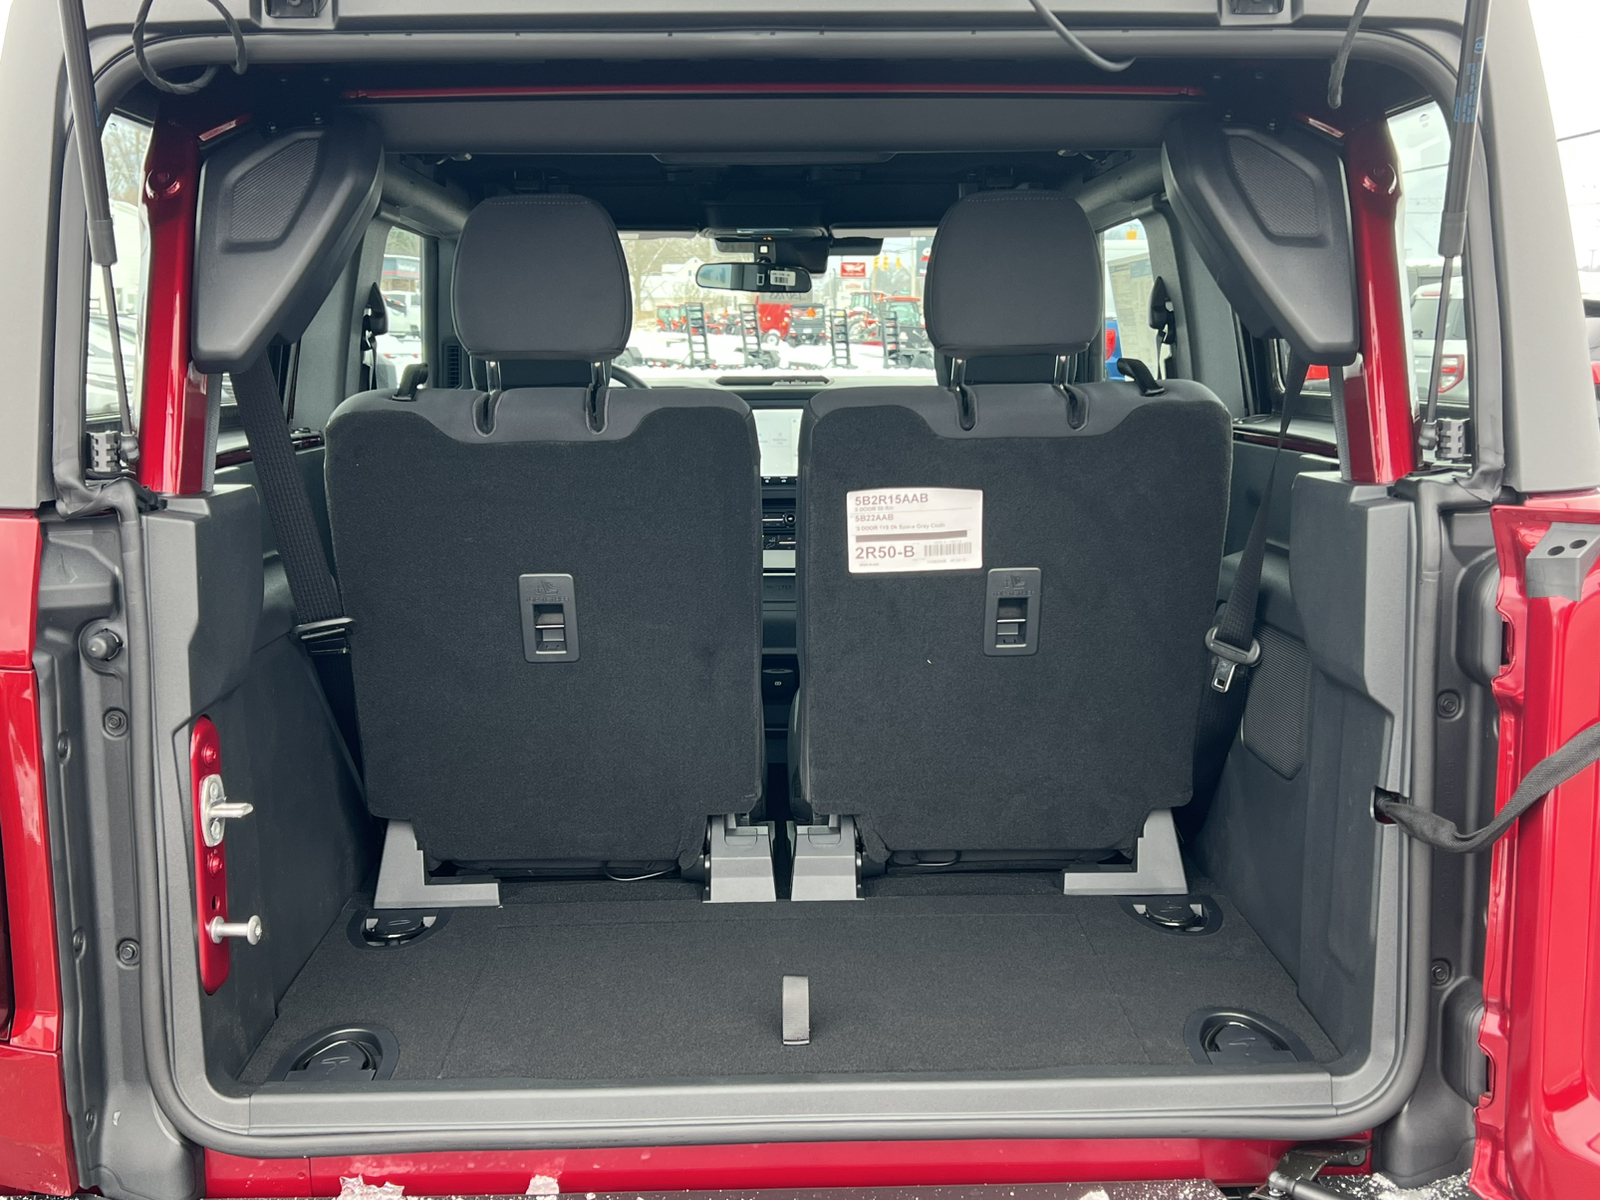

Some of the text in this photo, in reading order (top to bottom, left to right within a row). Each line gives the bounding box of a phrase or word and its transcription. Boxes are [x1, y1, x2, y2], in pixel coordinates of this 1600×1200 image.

[855, 493, 929, 506] 5B2R15AAB
[855, 514, 894, 522] 5B22AAB
[855, 545, 915, 559] 2R50-B
